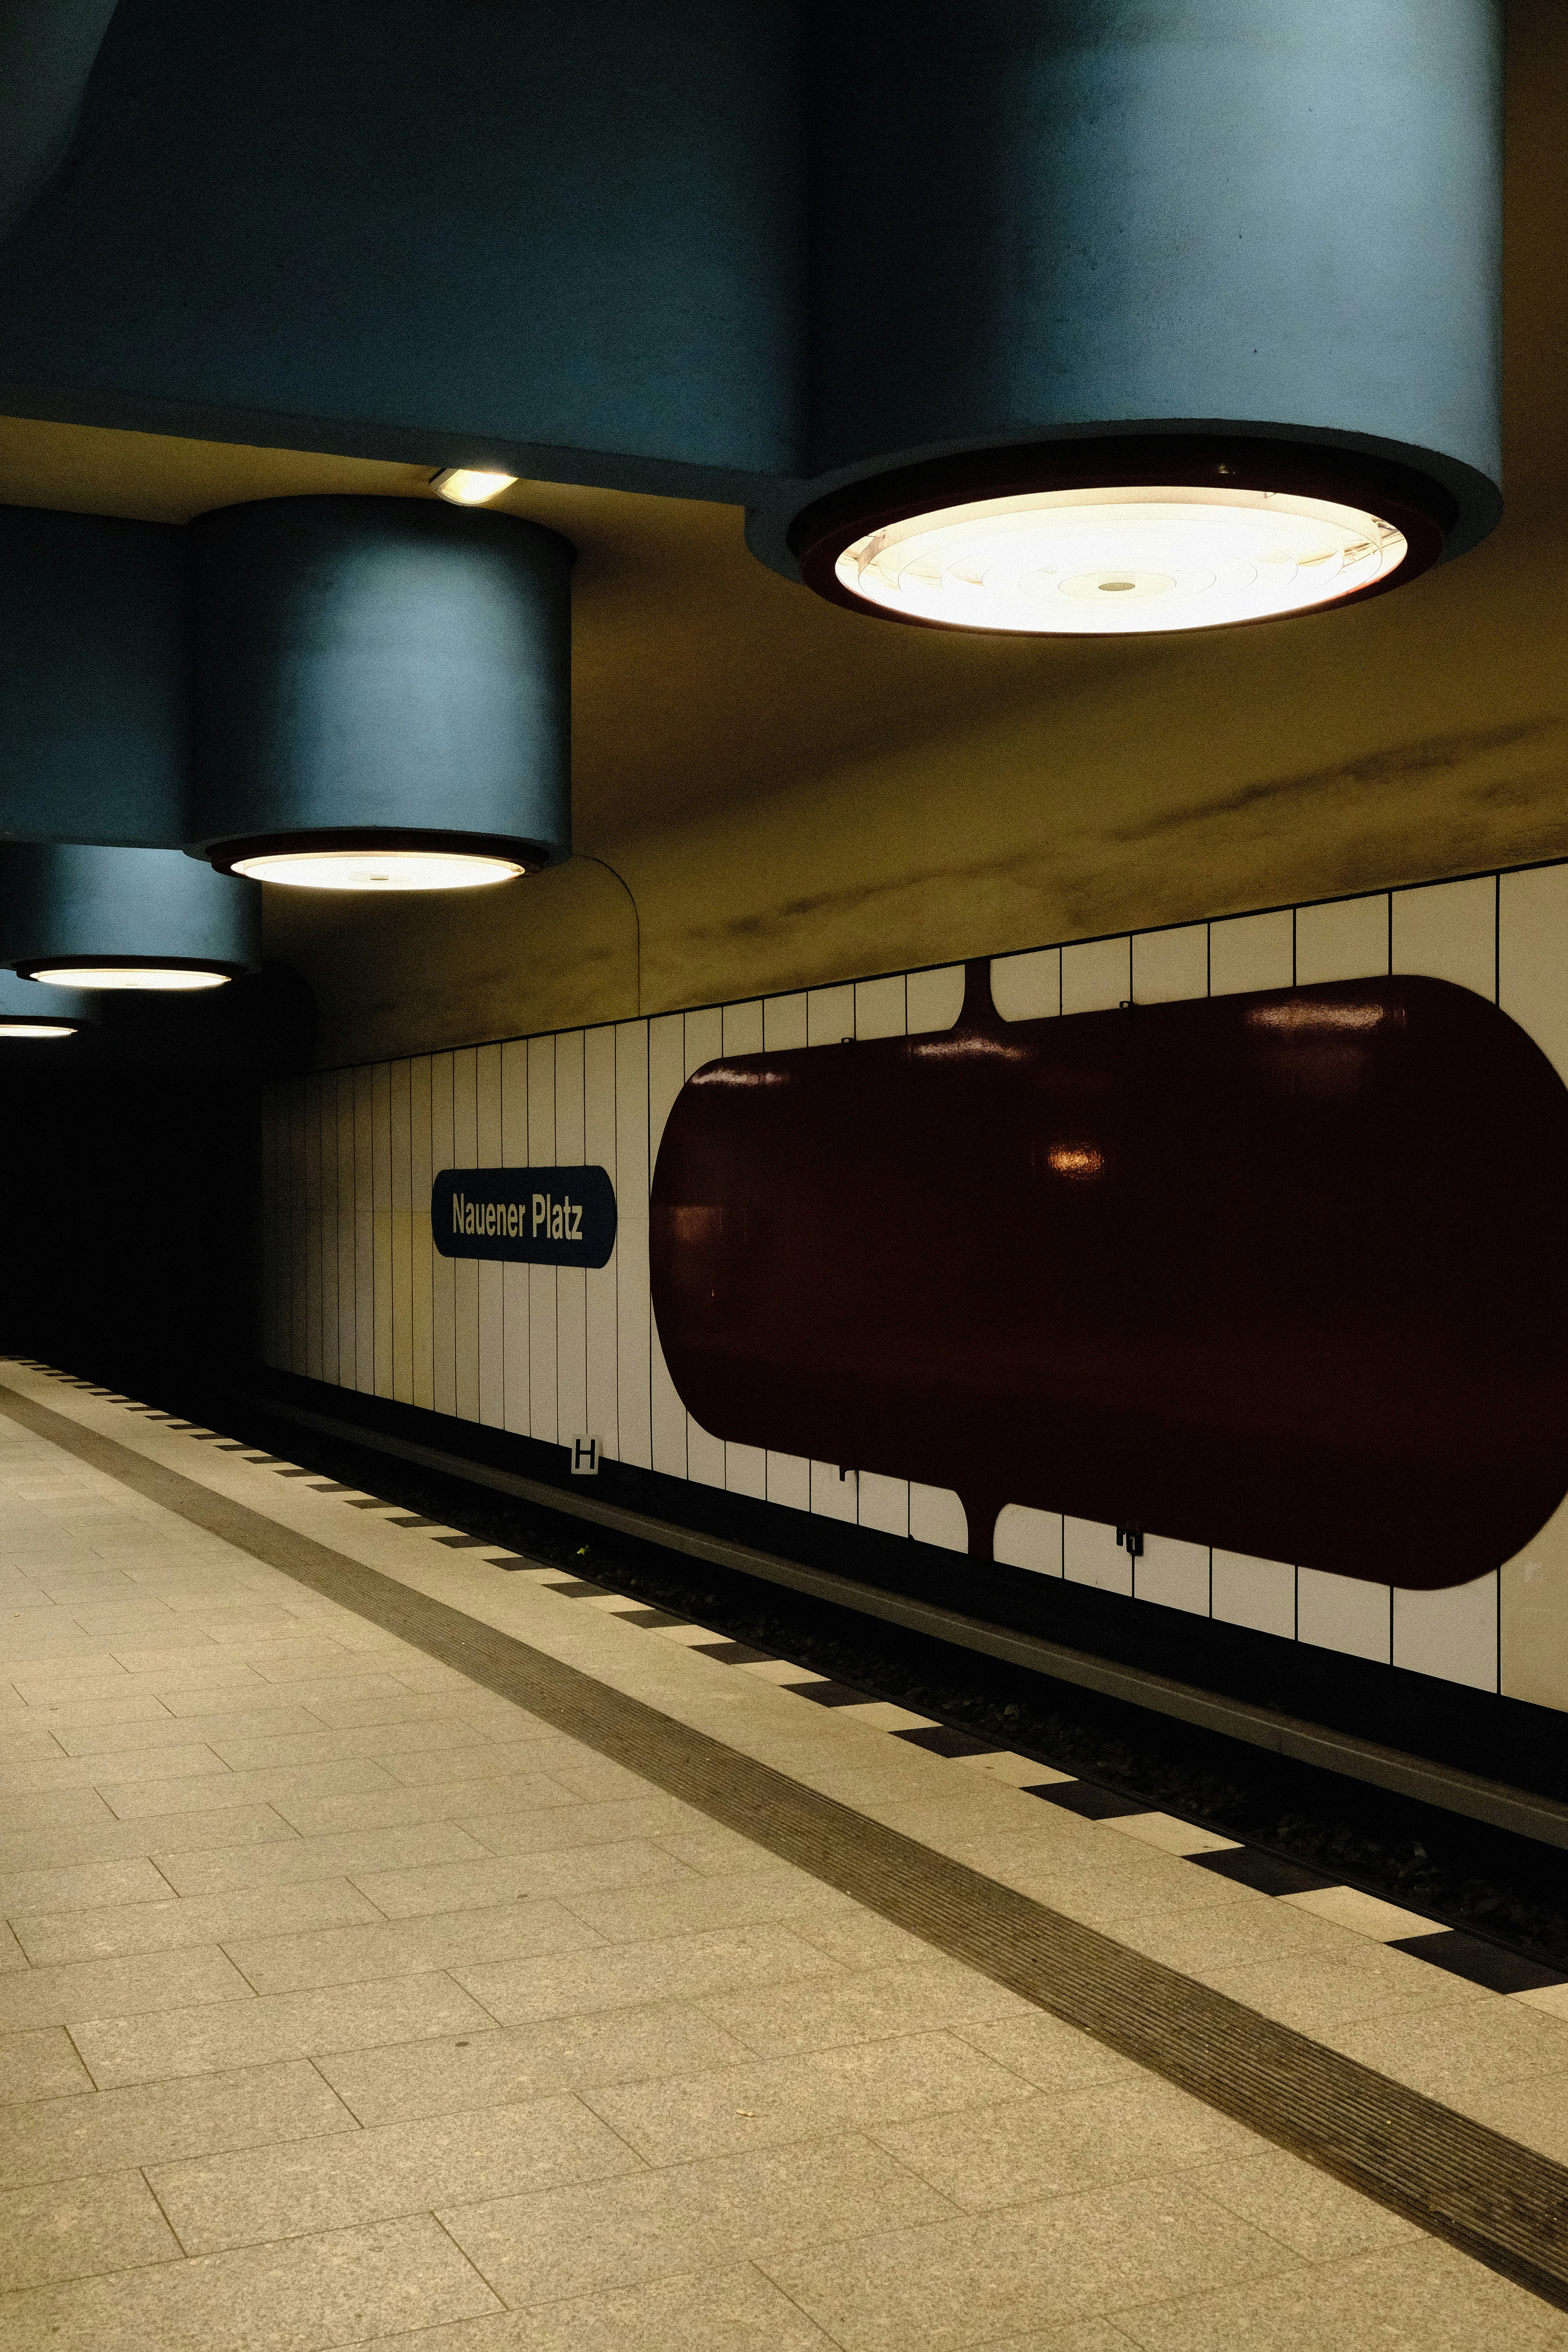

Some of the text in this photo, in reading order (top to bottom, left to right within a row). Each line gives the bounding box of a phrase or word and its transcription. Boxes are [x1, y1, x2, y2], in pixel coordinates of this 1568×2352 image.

[453, 1193, 582, 1240] Nauener Platz
[575, 1439, 595, 1469] H
